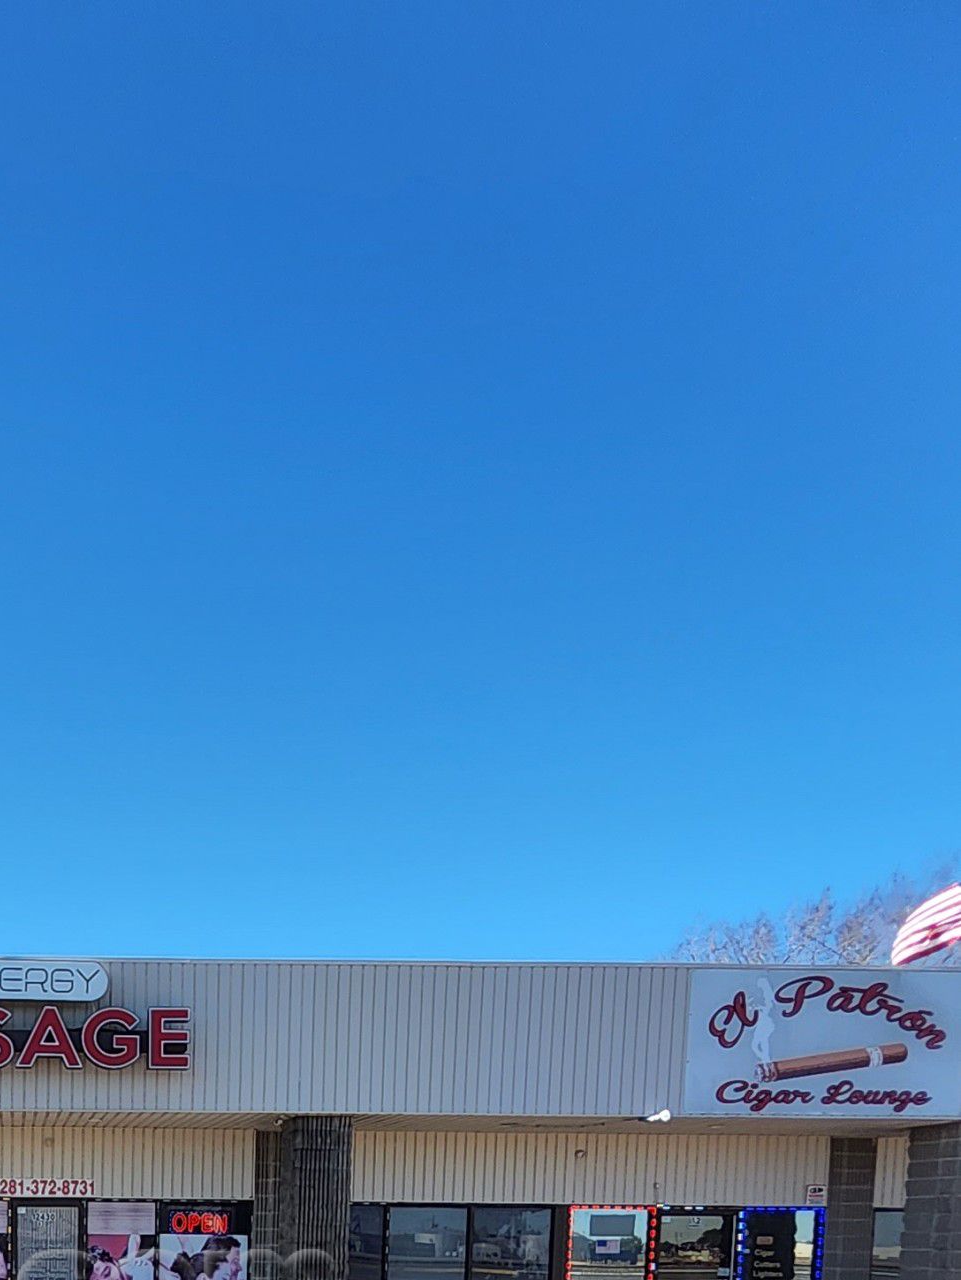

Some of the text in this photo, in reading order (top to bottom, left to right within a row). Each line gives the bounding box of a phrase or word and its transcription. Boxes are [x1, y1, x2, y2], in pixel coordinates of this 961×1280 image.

[709, 975, 947, 1050] El Patrón
[715, 1079, 933, 1113] Cigar Lounge
[172, 1211, 228, 1233] OPEN
